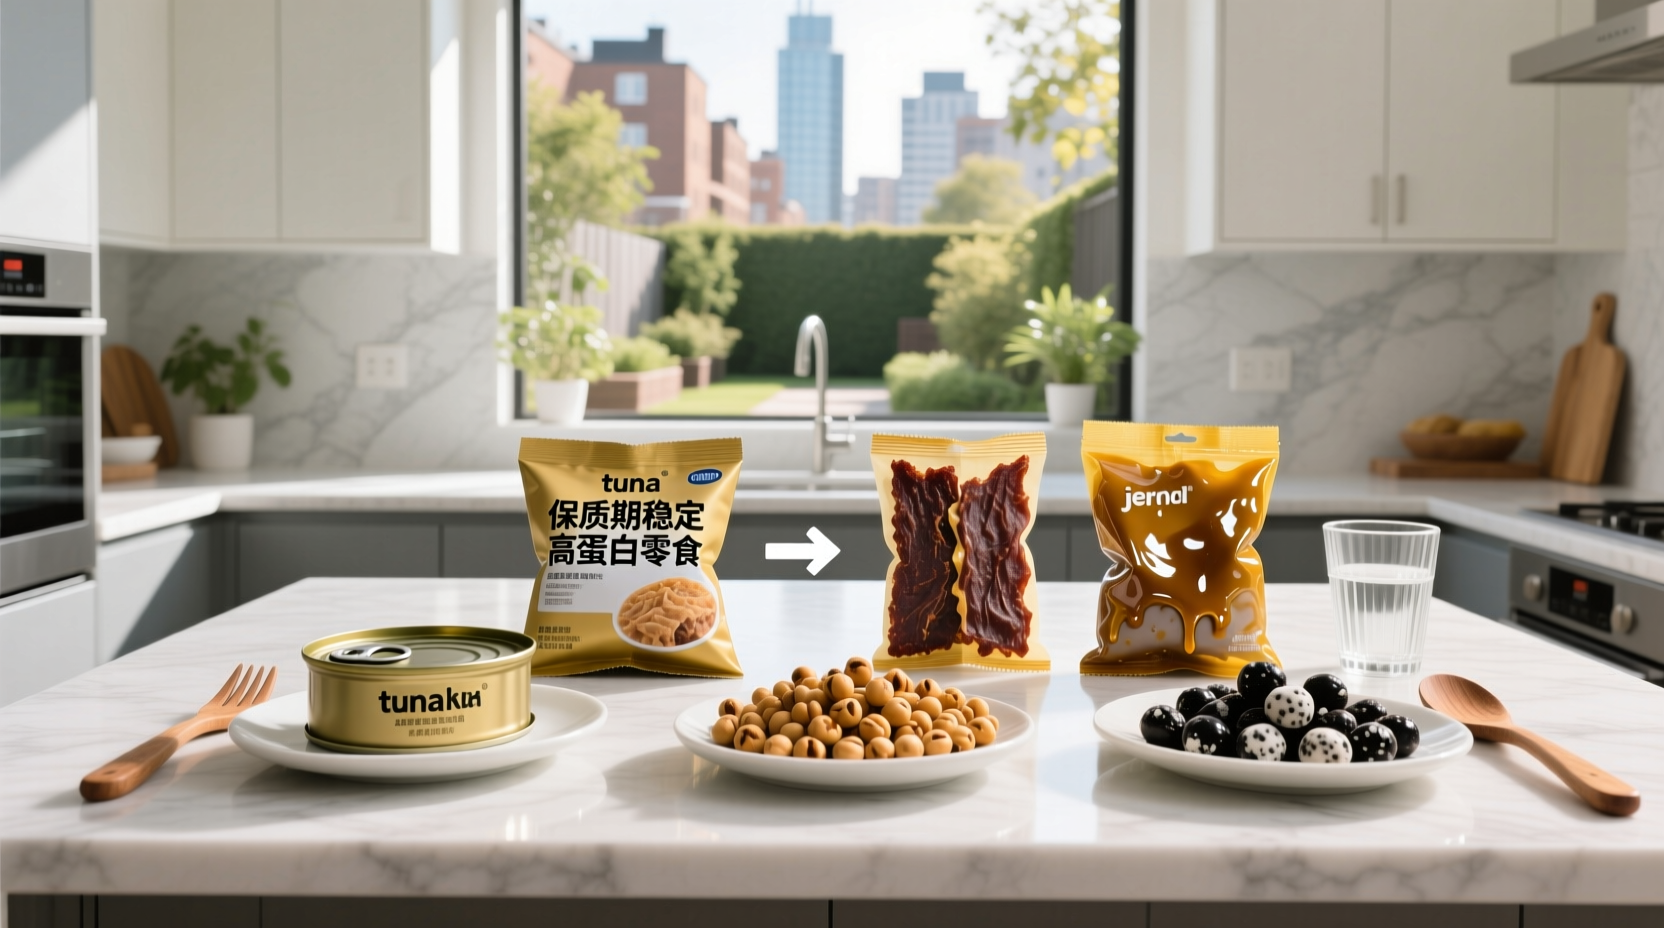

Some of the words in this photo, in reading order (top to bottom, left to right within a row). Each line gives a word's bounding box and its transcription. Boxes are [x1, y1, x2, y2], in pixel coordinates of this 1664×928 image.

[602, 474, 661, 493] tuna
[548, 499, 705, 531] 保质期稳定
[549, 532, 703, 567] 高蛋白零食
